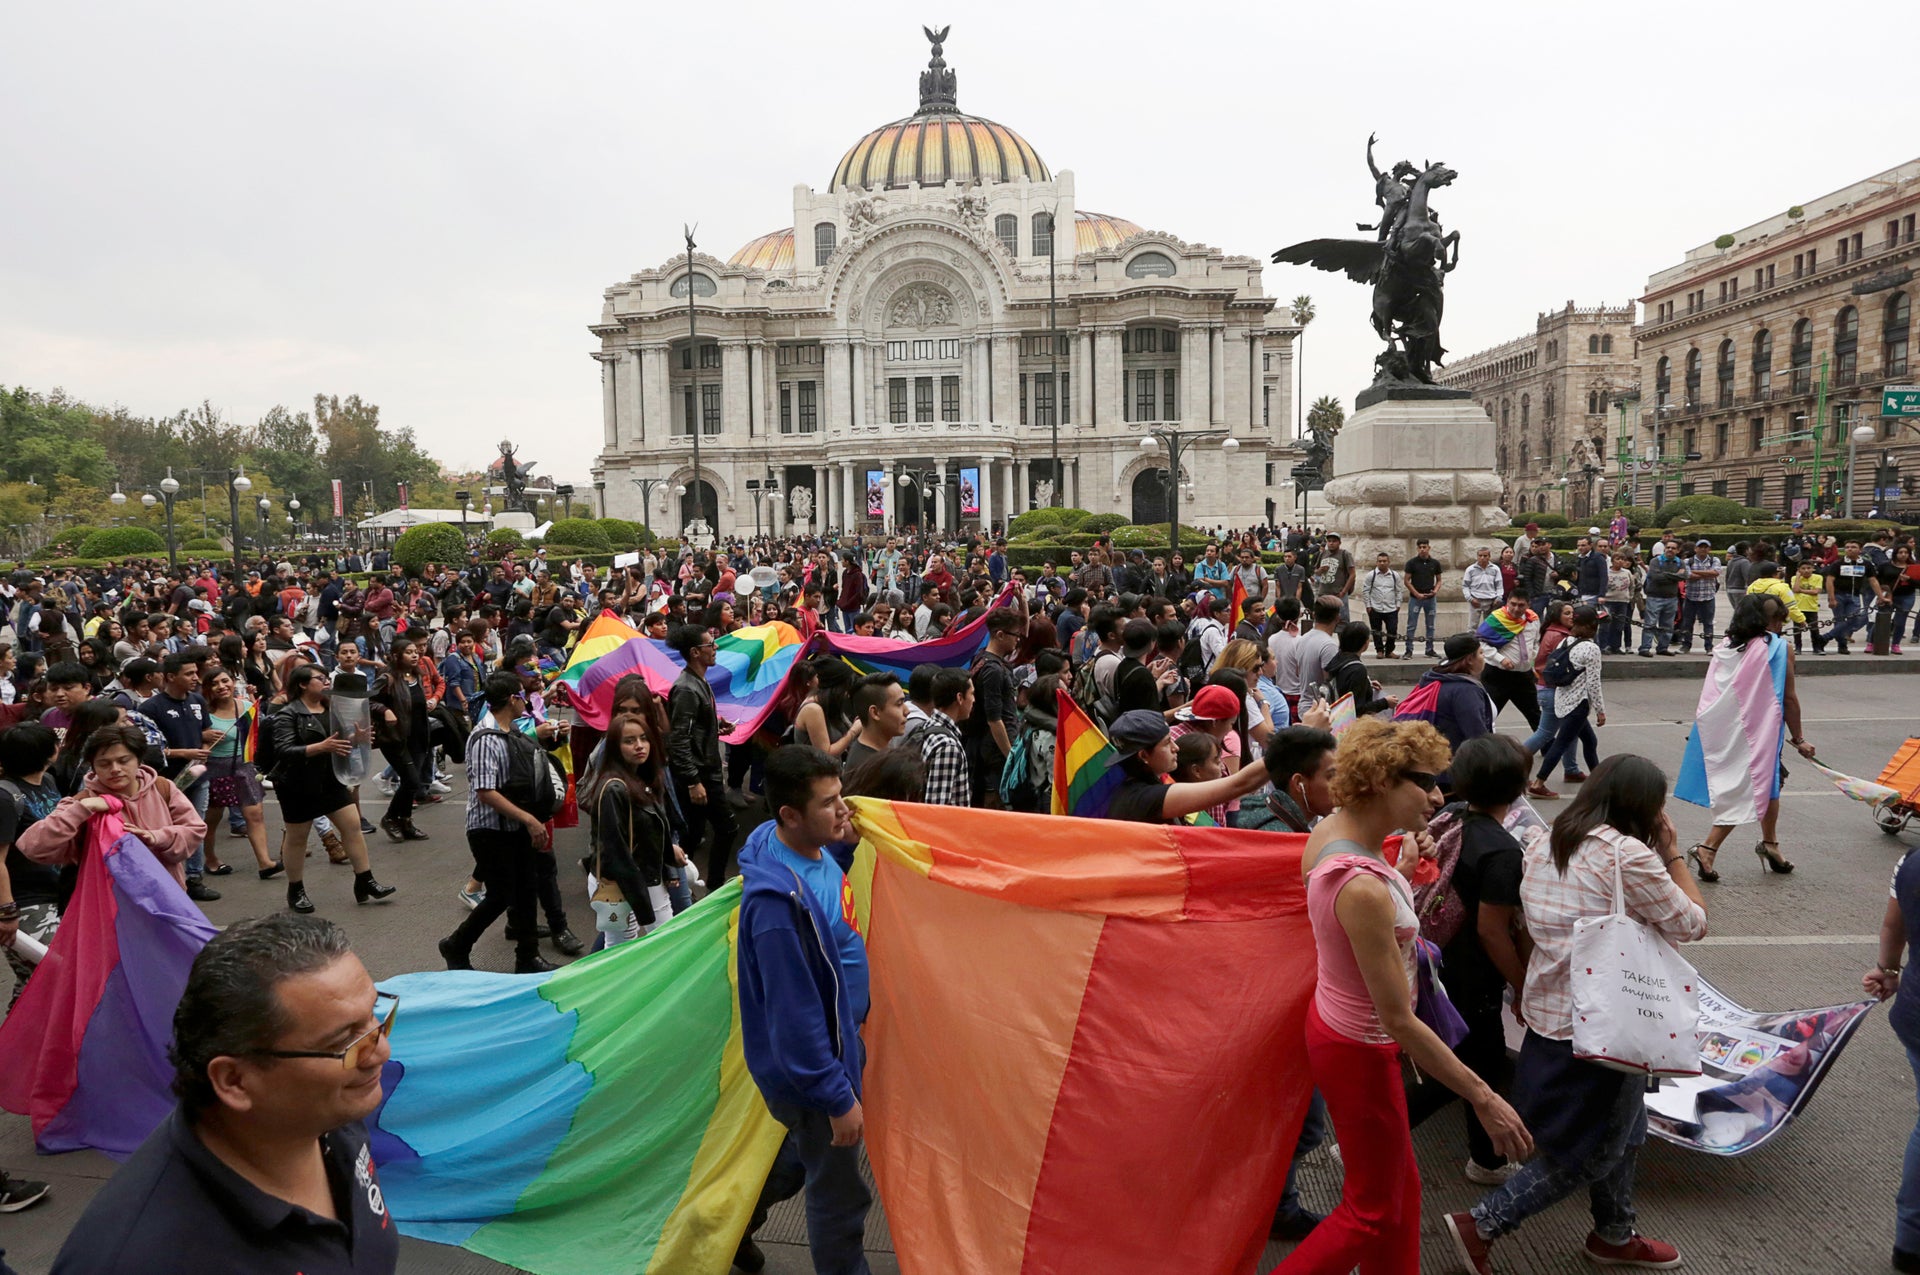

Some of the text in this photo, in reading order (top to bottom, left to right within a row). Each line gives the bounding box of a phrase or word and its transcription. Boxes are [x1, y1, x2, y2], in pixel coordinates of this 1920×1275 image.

[873, 272, 970, 322] PALACIO DE BELLAS ARTES
[1621, 985, 1671, 1002] anywhere
[1636, 1007, 1664, 1020] TOUS
